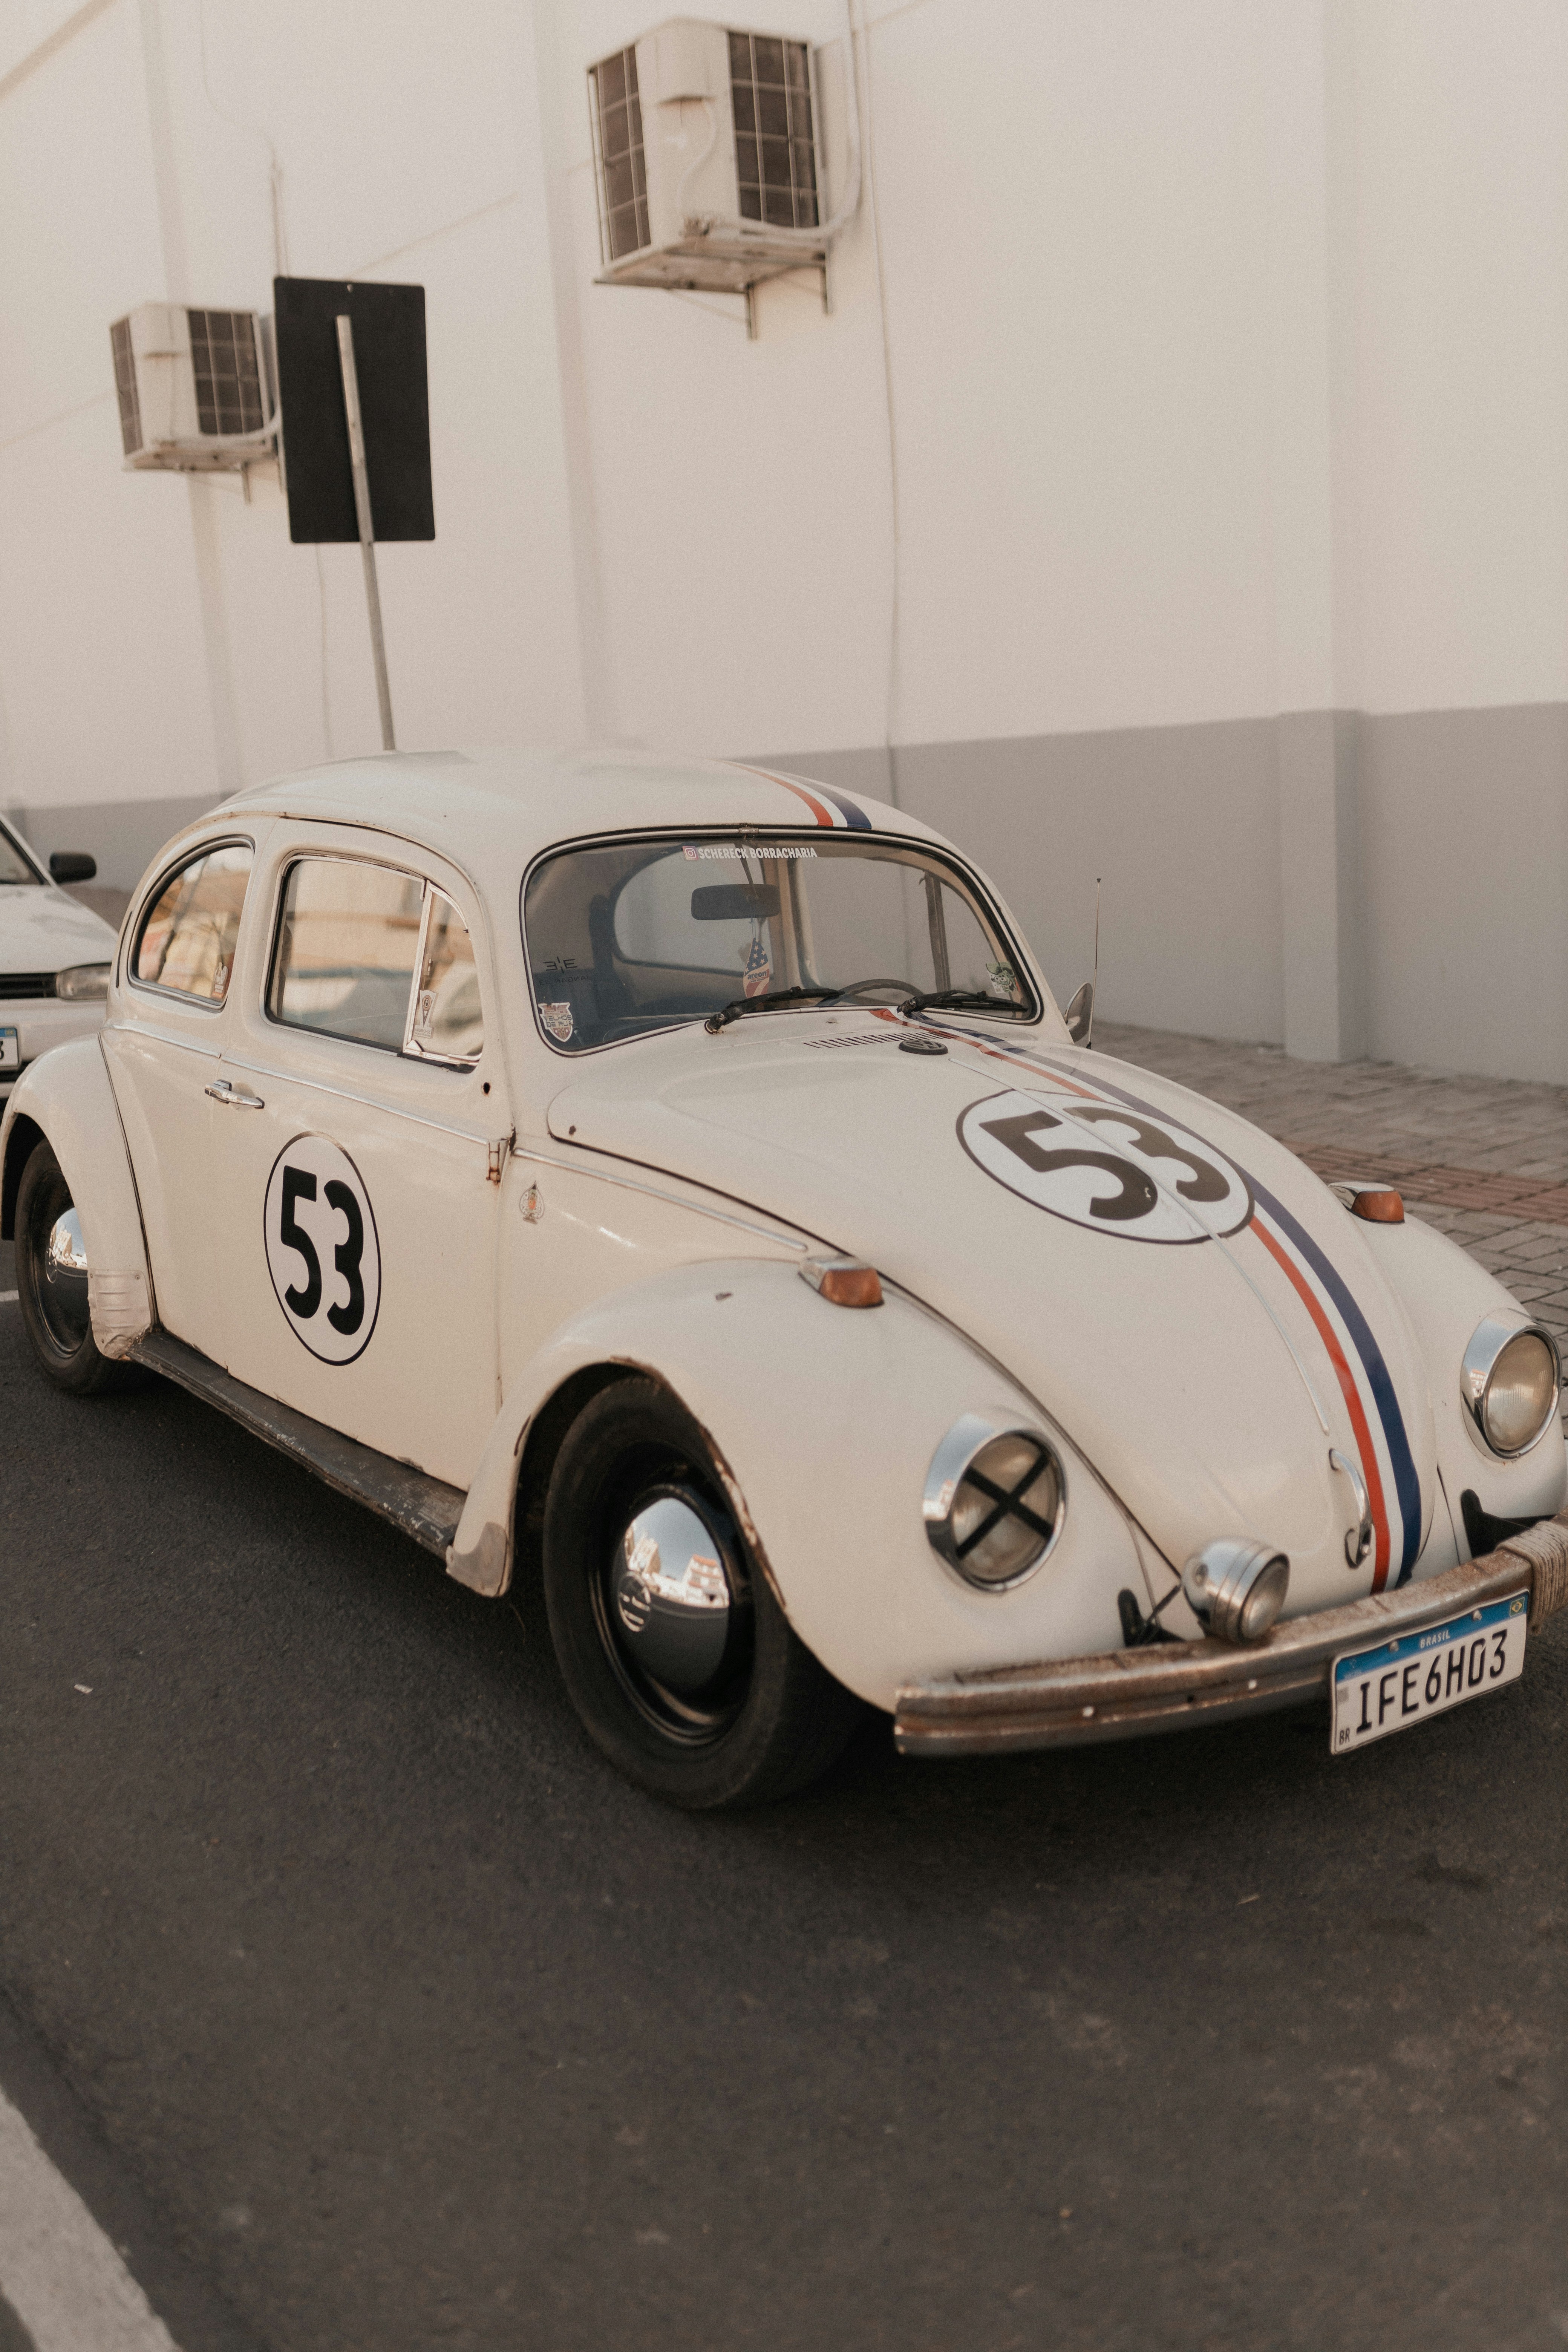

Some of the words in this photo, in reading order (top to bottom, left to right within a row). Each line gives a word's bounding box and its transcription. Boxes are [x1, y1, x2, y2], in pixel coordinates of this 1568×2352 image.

[698, 848, 750, 859] SCHERECK
[750, 847, 818, 859] BORRACHARIA
[747, 971, 767, 980] areon
[978, 1106, 1231, 1221] 53
[280, 1165, 365, 1336] 53
[1419, 1630, 1450, 1649] BRASIL
[1356, 1628, 1508, 1734] IFE6H03
[1338, 1727, 1351, 1746] BR
